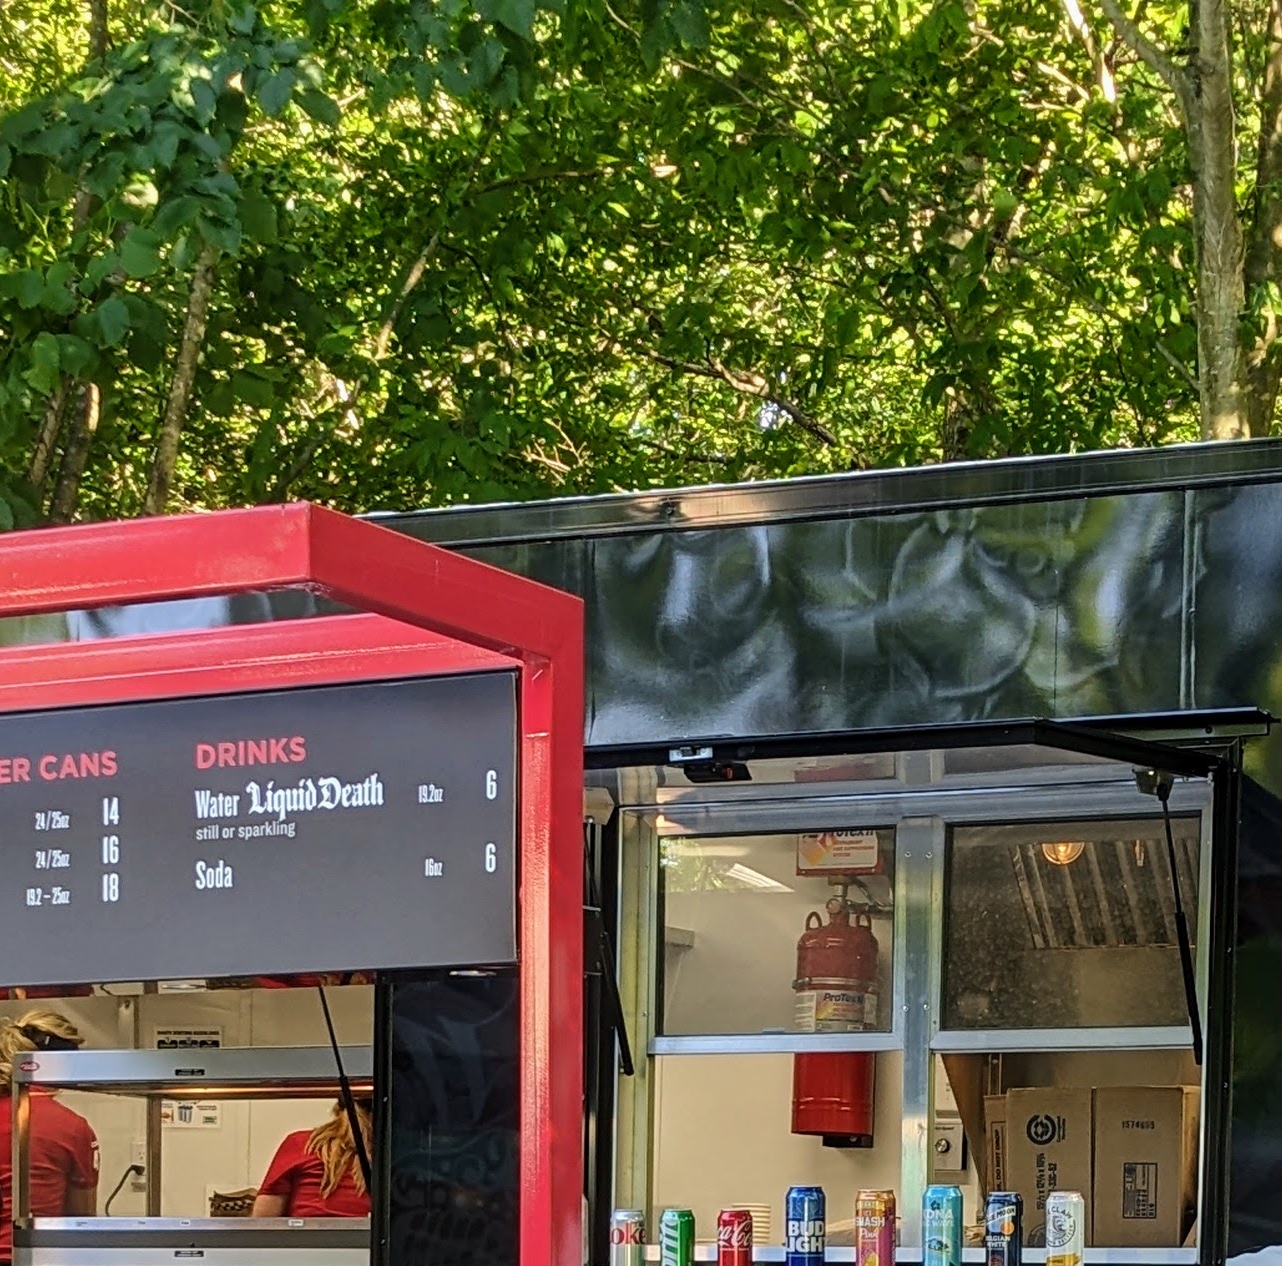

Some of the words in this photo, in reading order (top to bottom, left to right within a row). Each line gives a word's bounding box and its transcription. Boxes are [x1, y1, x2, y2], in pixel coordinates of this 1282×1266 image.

[39, 750, 119, 782] CANS
[195, 736, 307, 770] DRINKS
[194, 790, 240, 819] Water
[485, 770, 498, 800] 6
[102, 797, 119, 826] 14
[195, 824, 219, 841] still
[221, 826, 236, 840] or
[237, 820, 296, 840] sparkling
[102, 835, 119, 864] 16
[195, 860, 234, 890] Soda
[424, 858, 444, 877] 16oz
[484, 842, 497, 873] 6
[102, 873, 119, 903] 18
[610, 1222, 646, 1245] oke
[788, 1220, 824, 1237] BUD
